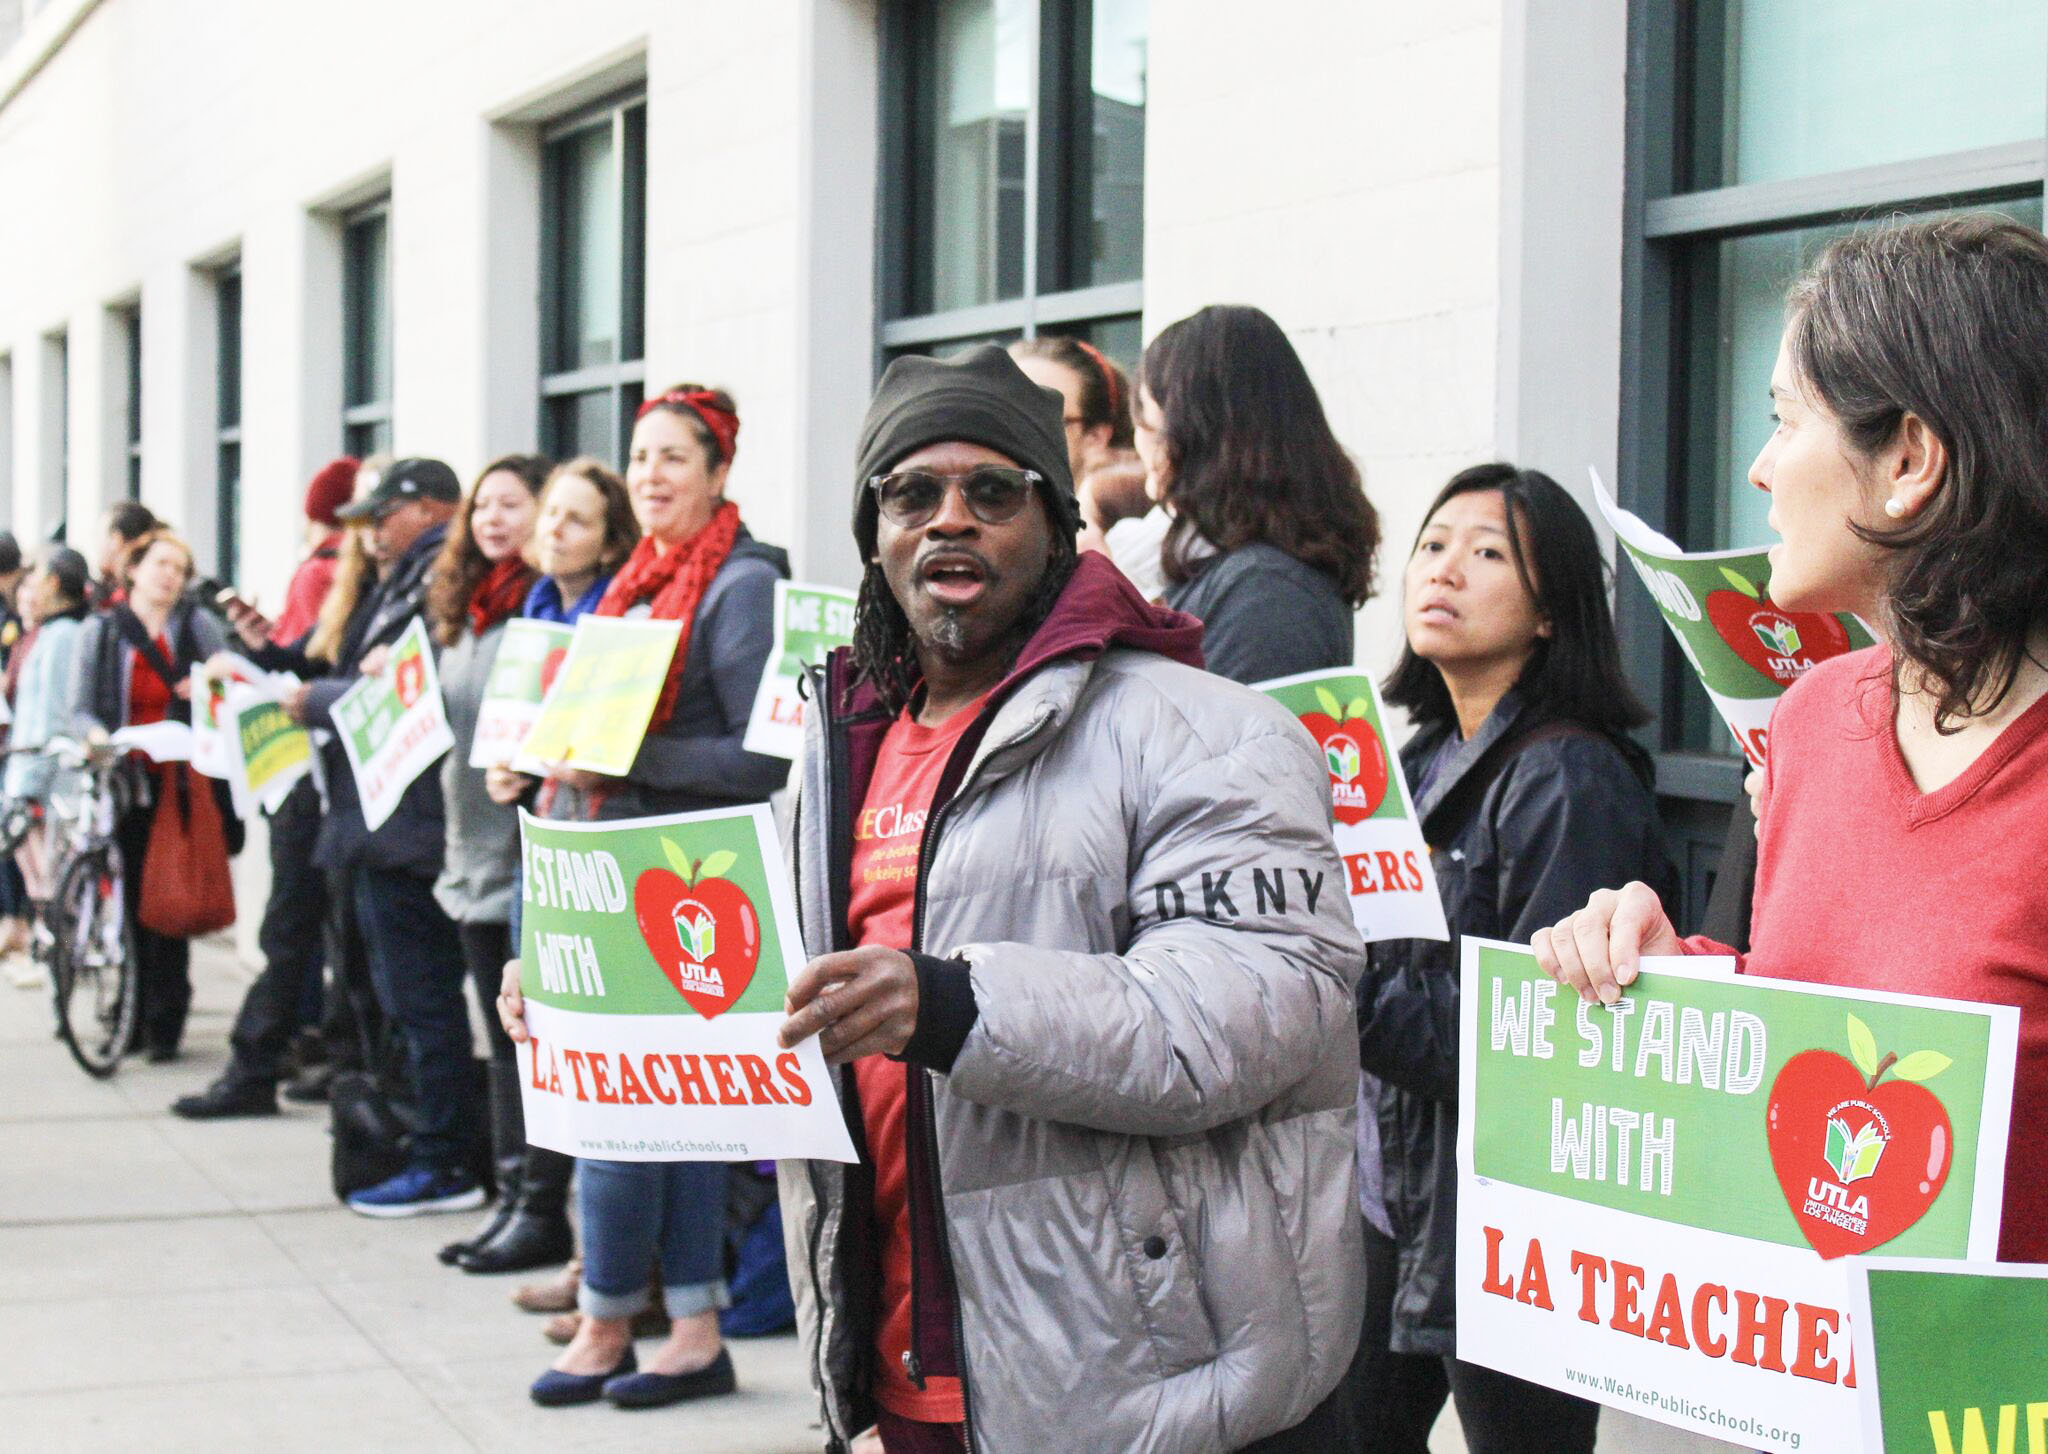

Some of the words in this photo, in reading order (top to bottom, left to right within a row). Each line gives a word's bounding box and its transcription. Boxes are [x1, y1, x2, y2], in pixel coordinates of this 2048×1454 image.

[532, 843, 628, 914] STAND
[1154, 867, 1324, 922] DKNY
[1342, 850, 1424, 897] ERS
[534, 929, 606, 997] WITH
[679, 961, 724, 986] UTLA
[1491, 976, 1557, 1060] WE
[1576, 996, 1766, 1095] STAND
[563, 1048, 813, 1106] TEACHERS
[579, 1140, 749, 1155] www.WeArePublicSchools.org
[1550, 1097, 1675, 1195] WITH
[1826, 1107, 1838, 1118] WE
[1837, 1100, 1851, 1110] ARE
[1850, 1100, 1874, 1111] PUBLIC
[1872, 1109, 1891, 1140] SCHOOLS
[1803, 1204, 1821, 1218] LOS
[1822, 1212, 1866, 1236] ANGELES
[1805, 1198, 1831, 1213] UNITED
[1831, 1208, 1868, 1228] TEACHERS
[1808, 1177, 1869, 1220] UTLA
[1482, 1226, 1554, 1311] LA
[1571, 1250, 1857, 1389] TEACHE
[1566, 1368, 1801, 1449] www.WeArePublicSchools.org
